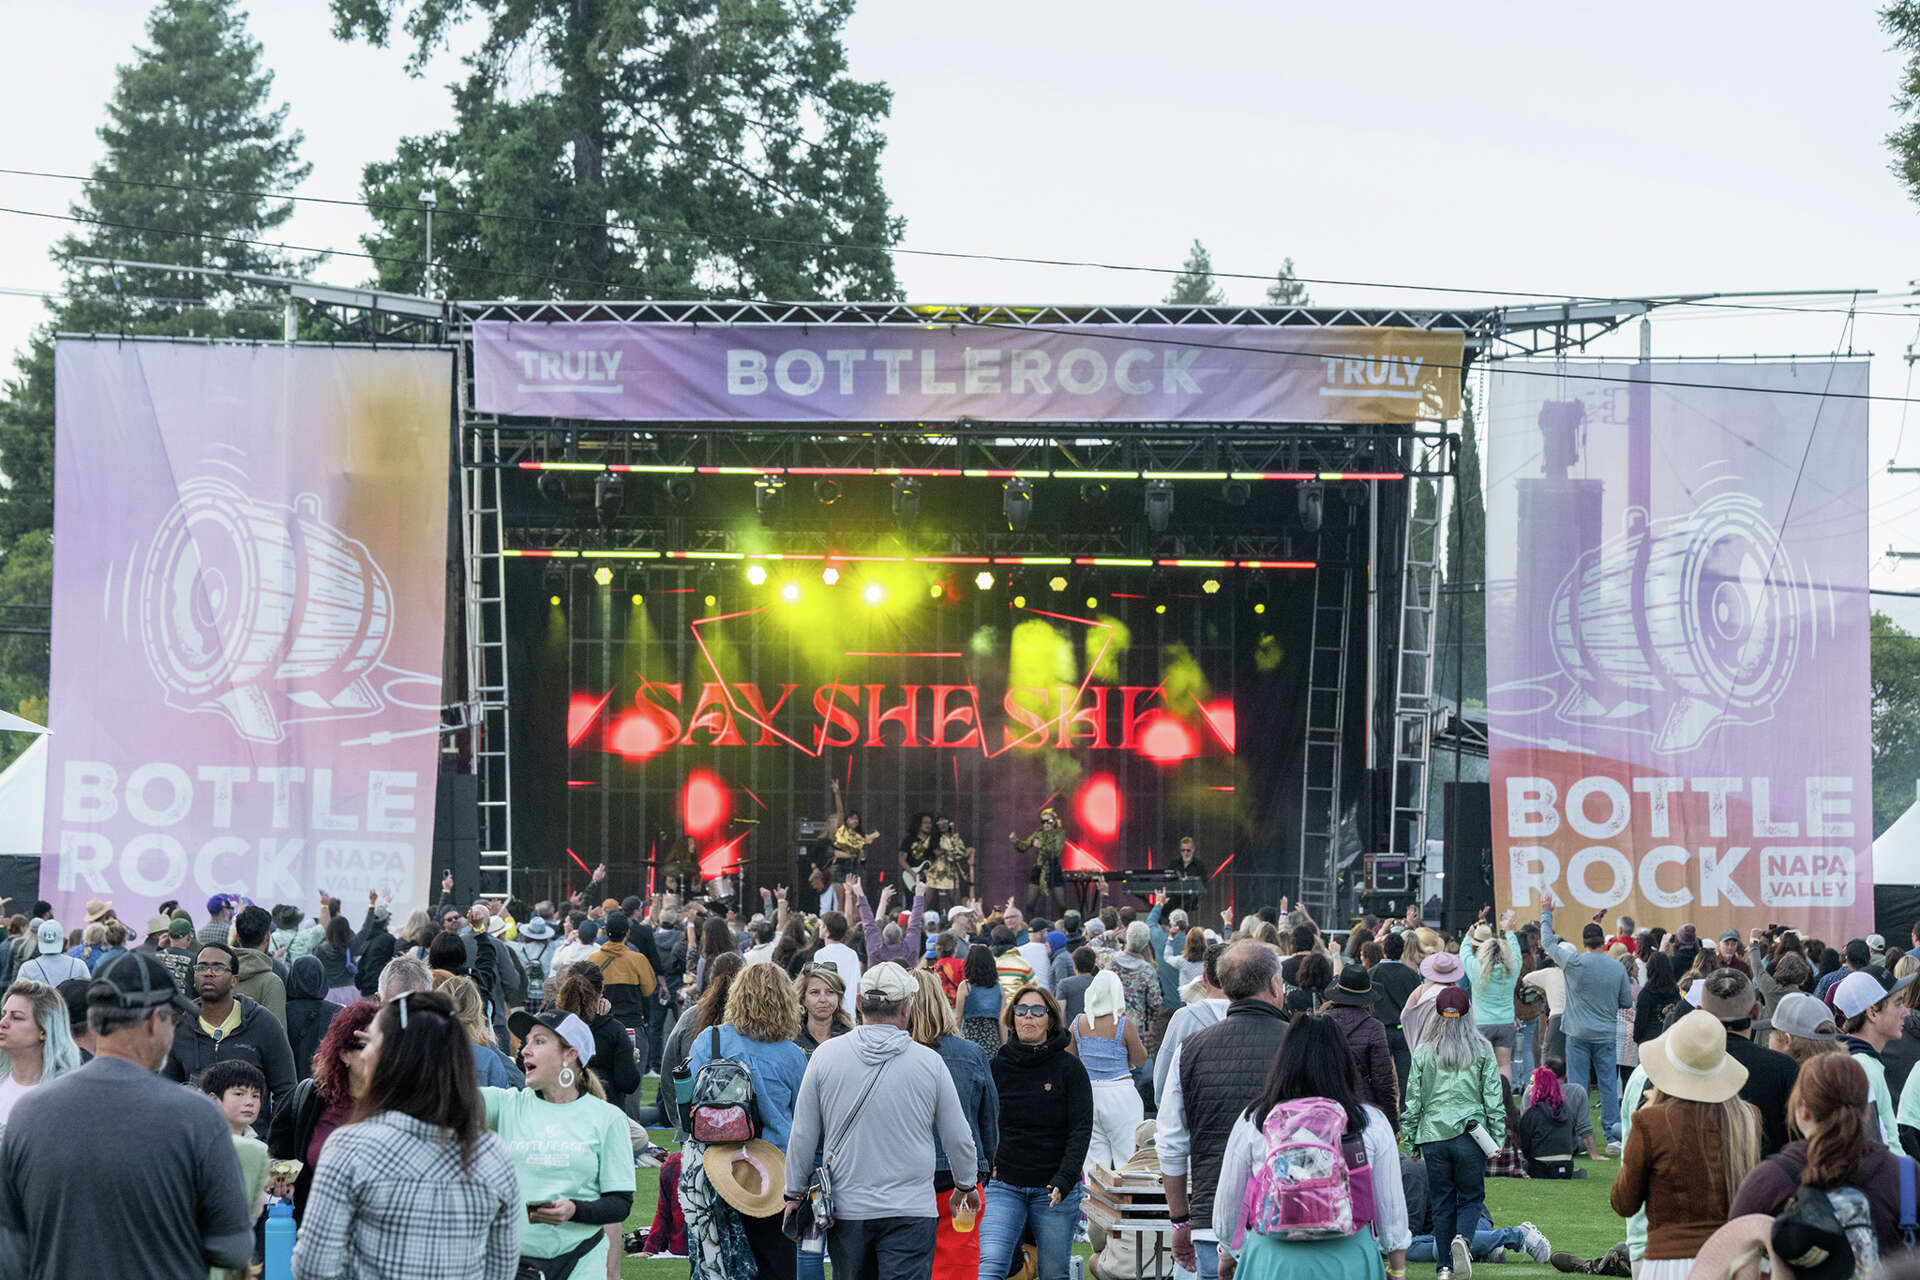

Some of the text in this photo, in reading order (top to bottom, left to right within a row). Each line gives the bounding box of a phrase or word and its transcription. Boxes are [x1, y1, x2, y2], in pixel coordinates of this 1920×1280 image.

[516, 350, 624, 381] TRULY
[727, 348, 1204, 396] BOTTLEROCK
[1320, 354, 1424, 387] TRULY
[635, 681, 801, 747] SAY
[813, 683, 980, 748] SHE
[62, 760, 418, 833] BOTTLE
[1506, 776, 1855, 839] BOTTLE
[57, 832, 309, 899] ROCK
[324, 848, 406, 872] NAPA
[1508, 845, 1757, 908] ROCK
[1767, 855, 1848, 876] NAPA
[1768, 881, 1848, 897] VALLEY
